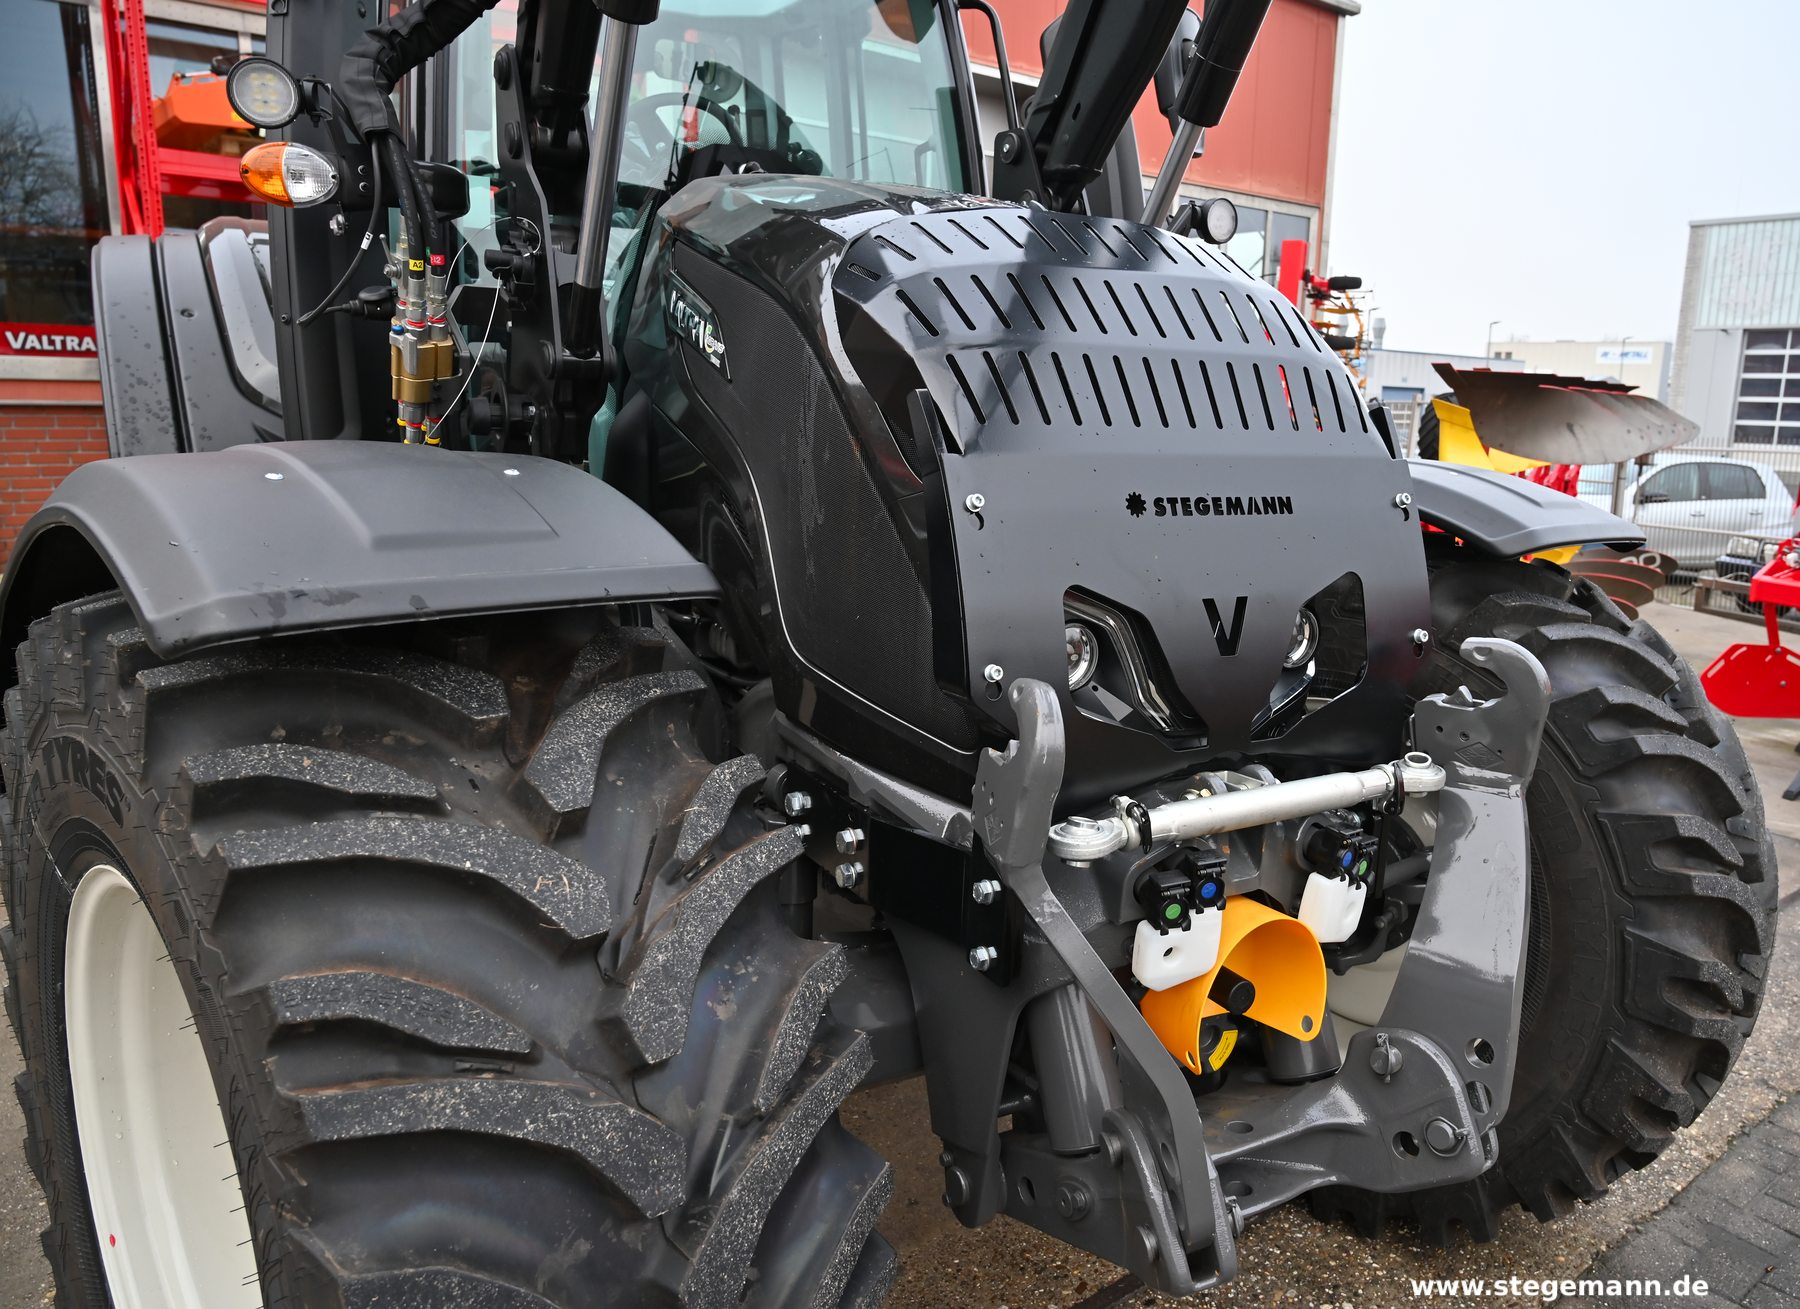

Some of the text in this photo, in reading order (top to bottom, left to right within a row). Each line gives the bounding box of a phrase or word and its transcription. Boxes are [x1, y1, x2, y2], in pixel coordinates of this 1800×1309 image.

[413, 261, 423, 269] A2
[5, 331, 97, 351] VALTRA
[1153, 496, 1294, 517] STEGEMANN
[1202, 596, 1249, 657] V
[41, 736, 124, 829] TYRES
